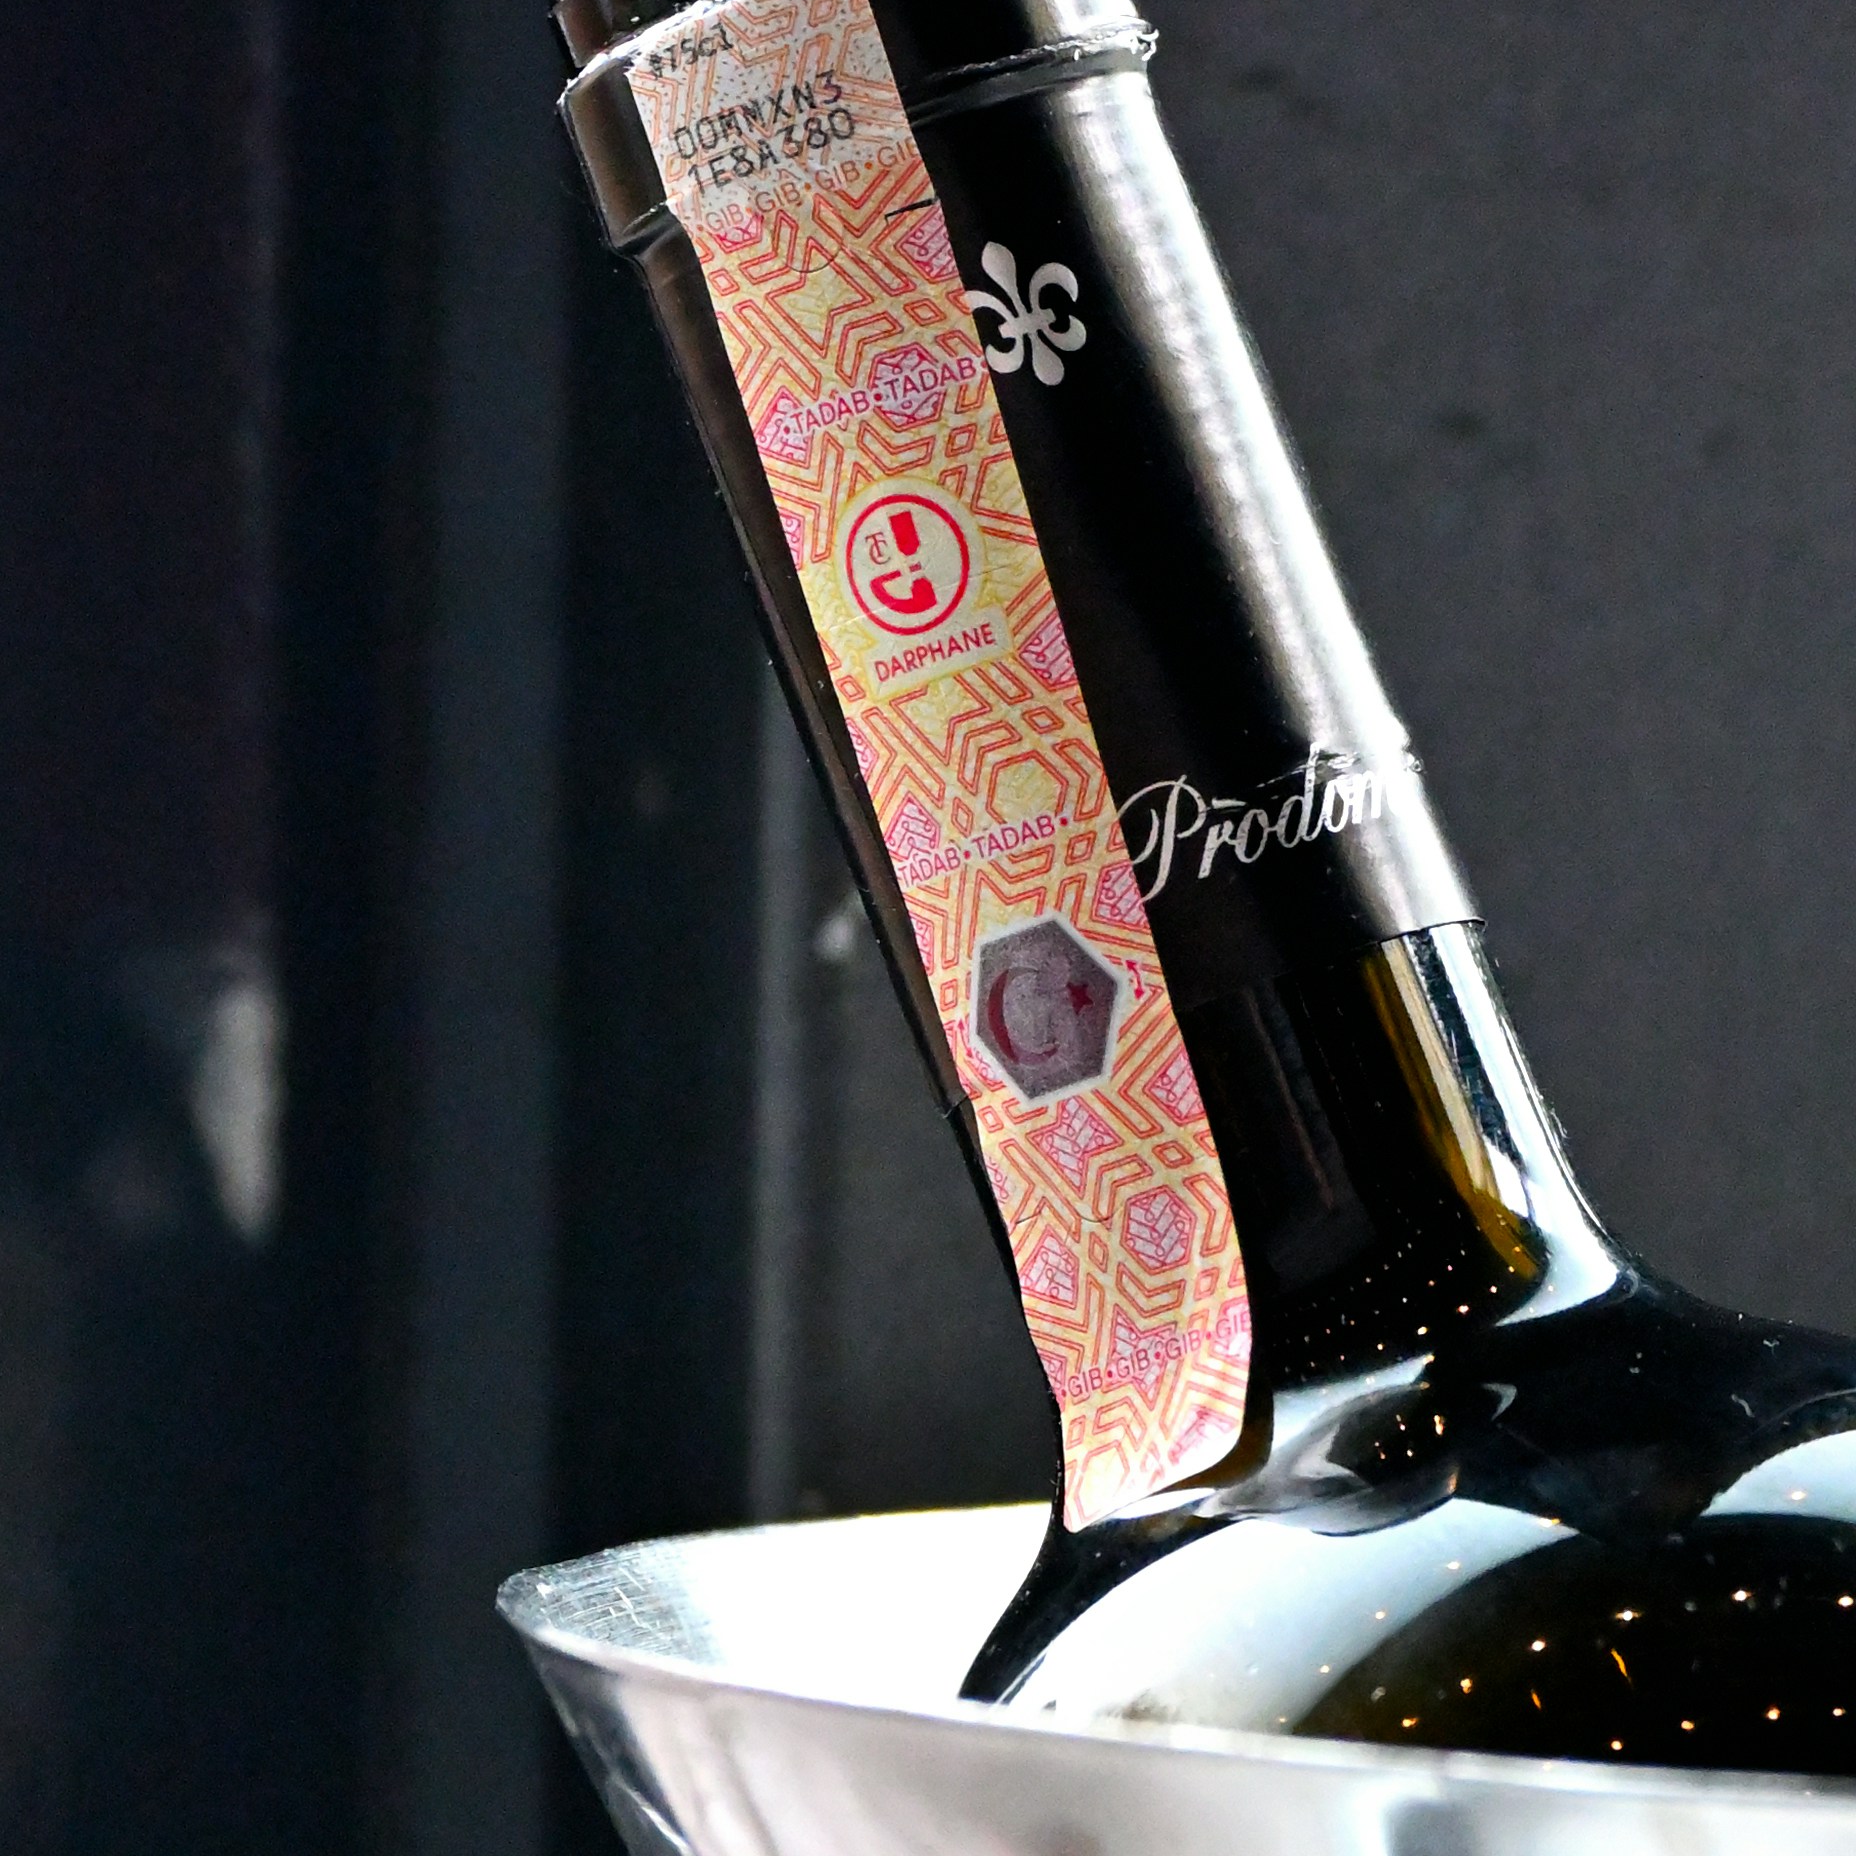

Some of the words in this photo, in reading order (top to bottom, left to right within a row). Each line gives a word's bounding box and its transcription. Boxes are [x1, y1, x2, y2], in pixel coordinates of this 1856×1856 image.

[705, 204, 745, 232] GIB
[755, 182, 802, 213] GIB
[815, 161, 860, 191] GIB
[790, 391, 870, 434] TADAB
[884, 357, 977, 400] TADAB
[874, 622, 997, 682] DARPHANE
[898, 847, 961, 888] TADAB
[971, 815, 1056, 858] TADAB
[1067, 1367, 1103, 1398] GIB
[1116, 1348, 1150, 1378] GIB
[1165, 1329, 1201, 1360] GIB
